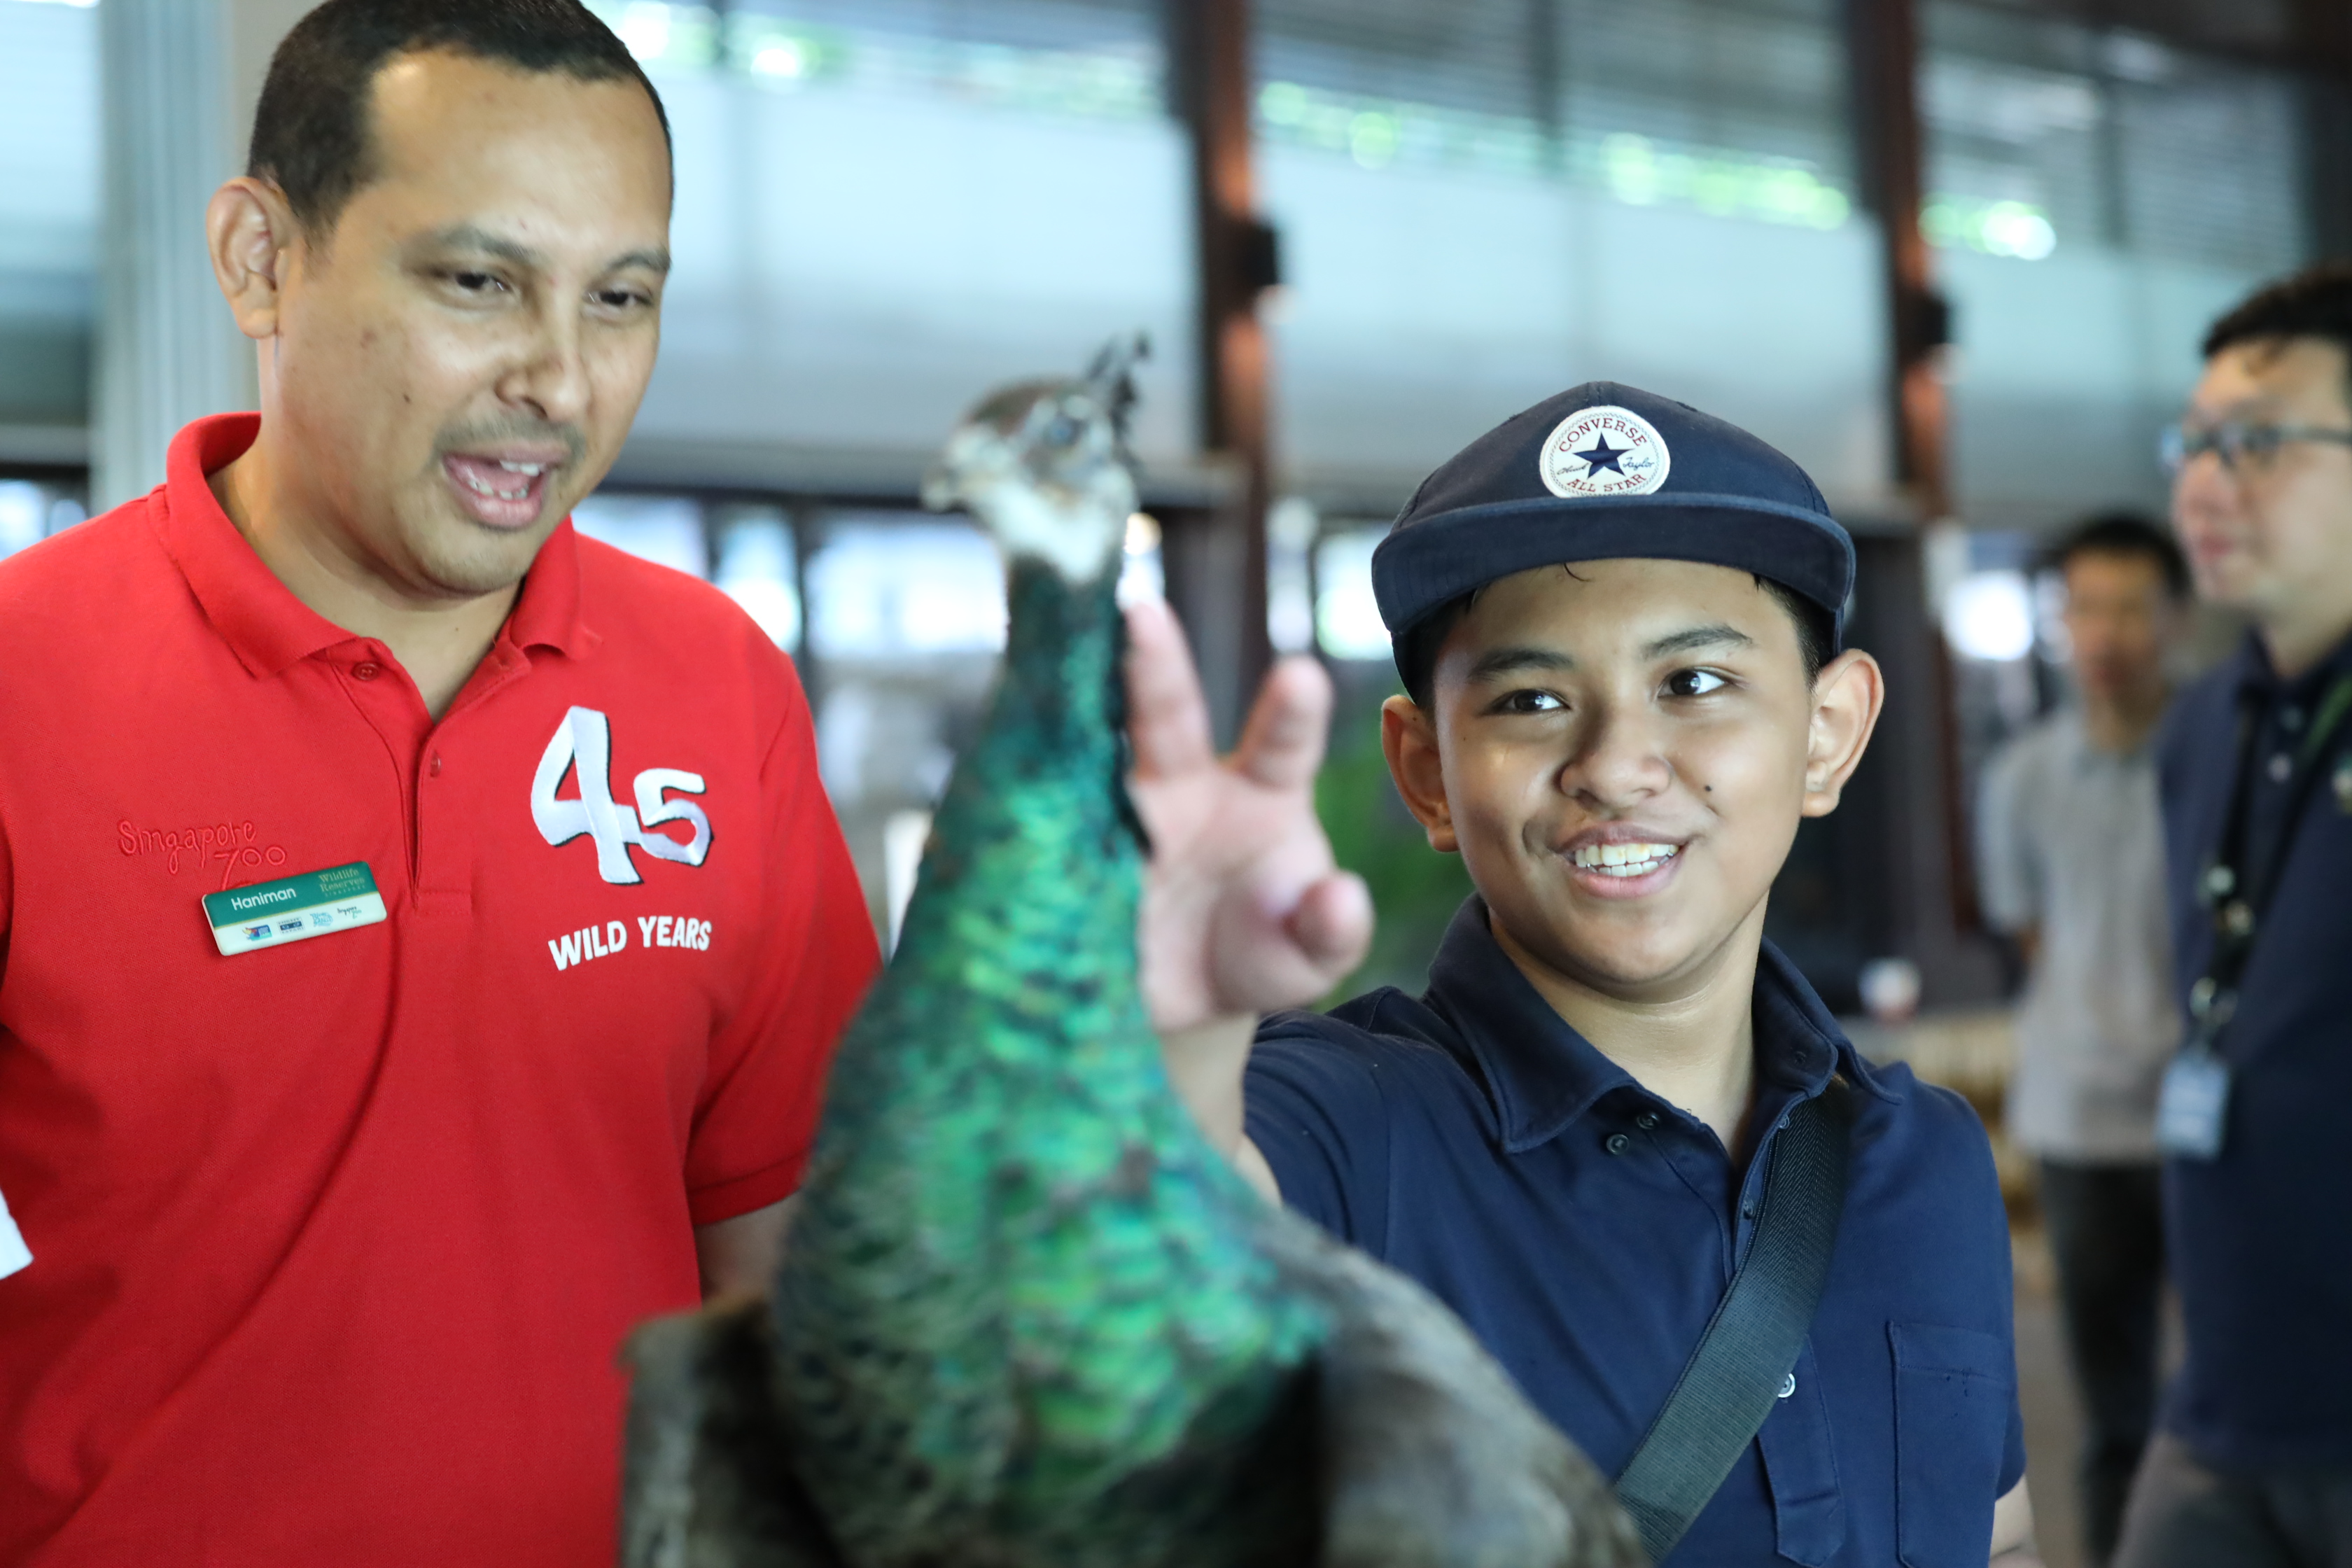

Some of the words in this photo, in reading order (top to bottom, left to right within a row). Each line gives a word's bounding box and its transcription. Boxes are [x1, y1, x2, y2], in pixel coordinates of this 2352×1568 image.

[1559, 418, 1648, 452] CONVERSE
[1567, 478, 1596, 492] ALL
[1604, 473, 1647, 492] STAR
[530, 705, 713, 885] 45
[120, 820, 256, 874] Singapore
[318, 867, 359, 883] Wildlife
[320, 878, 365, 892] Reserves
[231, 888, 297, 911] Haniman
[547, 920, 627, 972] WILD
[638, 916, 712, 951] YEARS
